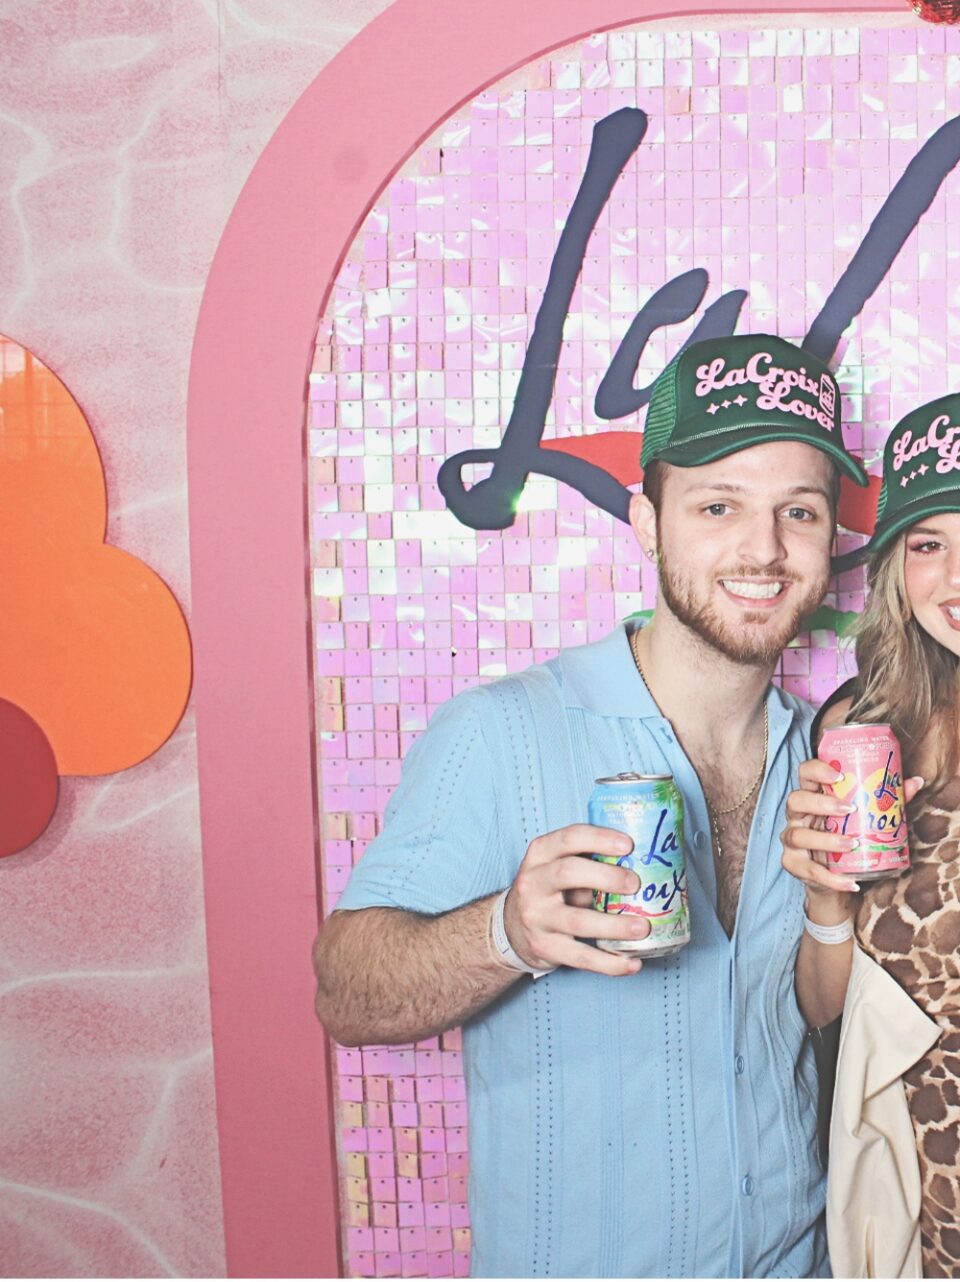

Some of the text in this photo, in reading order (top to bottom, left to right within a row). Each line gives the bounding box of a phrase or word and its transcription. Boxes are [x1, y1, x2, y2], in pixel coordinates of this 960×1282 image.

[695, 352, 819, 397] LaCroix
[756, 382, 835, 432] Lover
[873, 750, 902, 800] La
[640, 808, 679, 866] La
